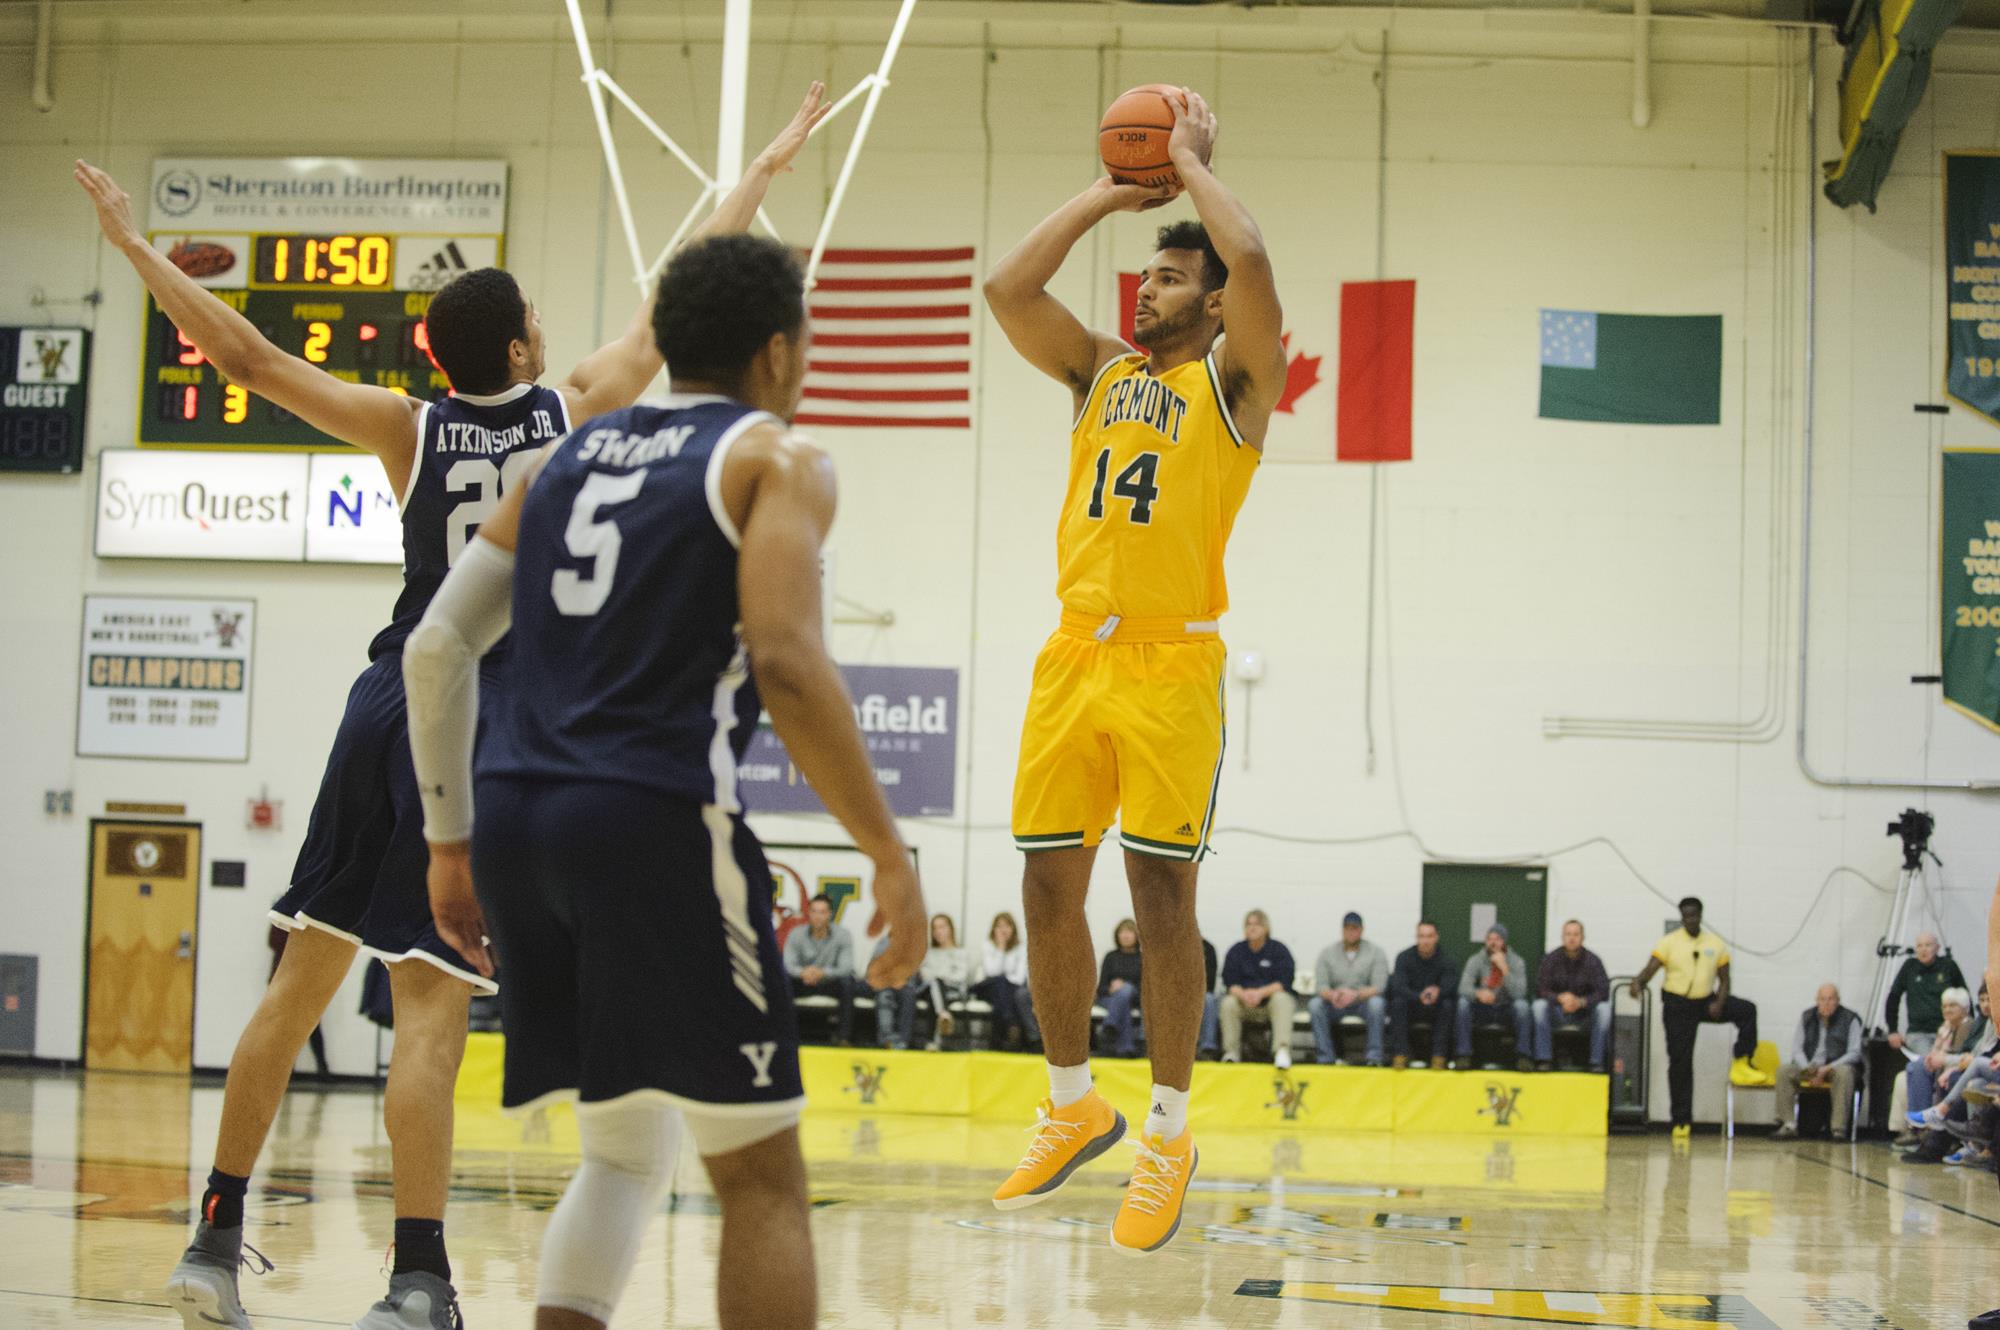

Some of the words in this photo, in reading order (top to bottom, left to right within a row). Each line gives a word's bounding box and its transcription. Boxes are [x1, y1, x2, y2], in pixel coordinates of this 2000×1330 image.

[1117, 132, 1147, 142] ROCK
[207, 175, 336, 199] Sheraton
[344, 176, 501, 203] Burlington
[273, 236, 390, 286] 11:50
[304, 322, 332, 362] 2
[3, 385, 68, 408] GUEST
[184, 385, 198, 420] 1
[223, 384, 248, 424] 3
[1100, 376, 1187, 443] ERMONT
[436, 423, 527, 455] ATKINSON
[104, 480, 291, 530] SymQuest
[1087, 446, 1160, 526] 14
[551, 467, 648, 616] 5
[92, 656, 242, 689] CHAMPIONS
[739, 1041, 778, 1088] Y
